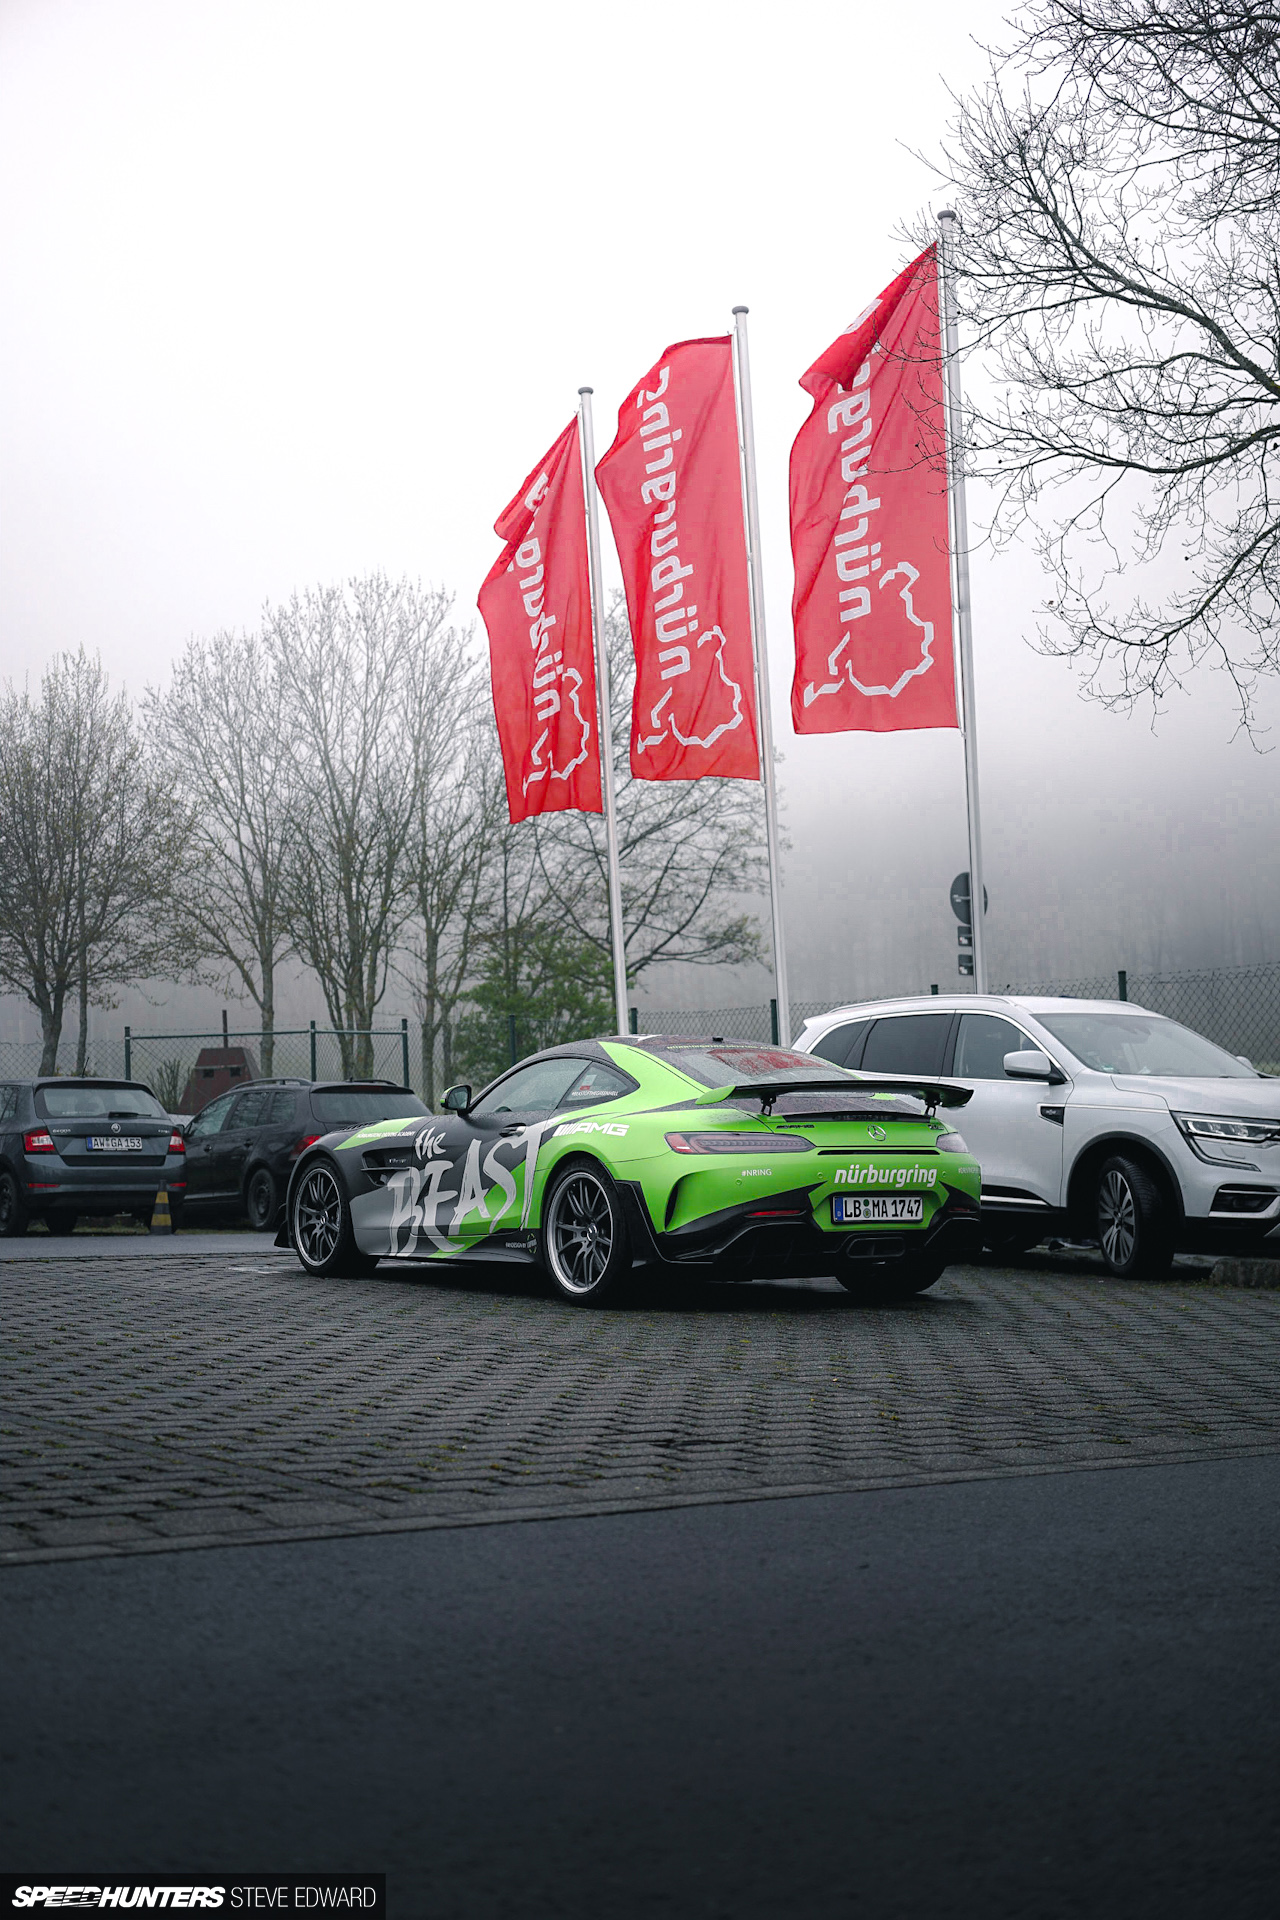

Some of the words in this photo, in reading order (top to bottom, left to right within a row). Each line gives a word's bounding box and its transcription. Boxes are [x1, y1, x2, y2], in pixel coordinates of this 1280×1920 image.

[570, 1122, 630, 1137] AMG
[111, 1138, 123, 1148] GA
[125, 1138, 142, 1148] 153
[415, 1126, 447, 1160] the
[387, 1115, 568, 1257] BEAST
[834, 1164, 938, 1188] nürburgring
[844, 1199, 862, 1218] LB
[872, 1199, 889, 1218] MA
[891, 1199, 921, 1218] 1747
